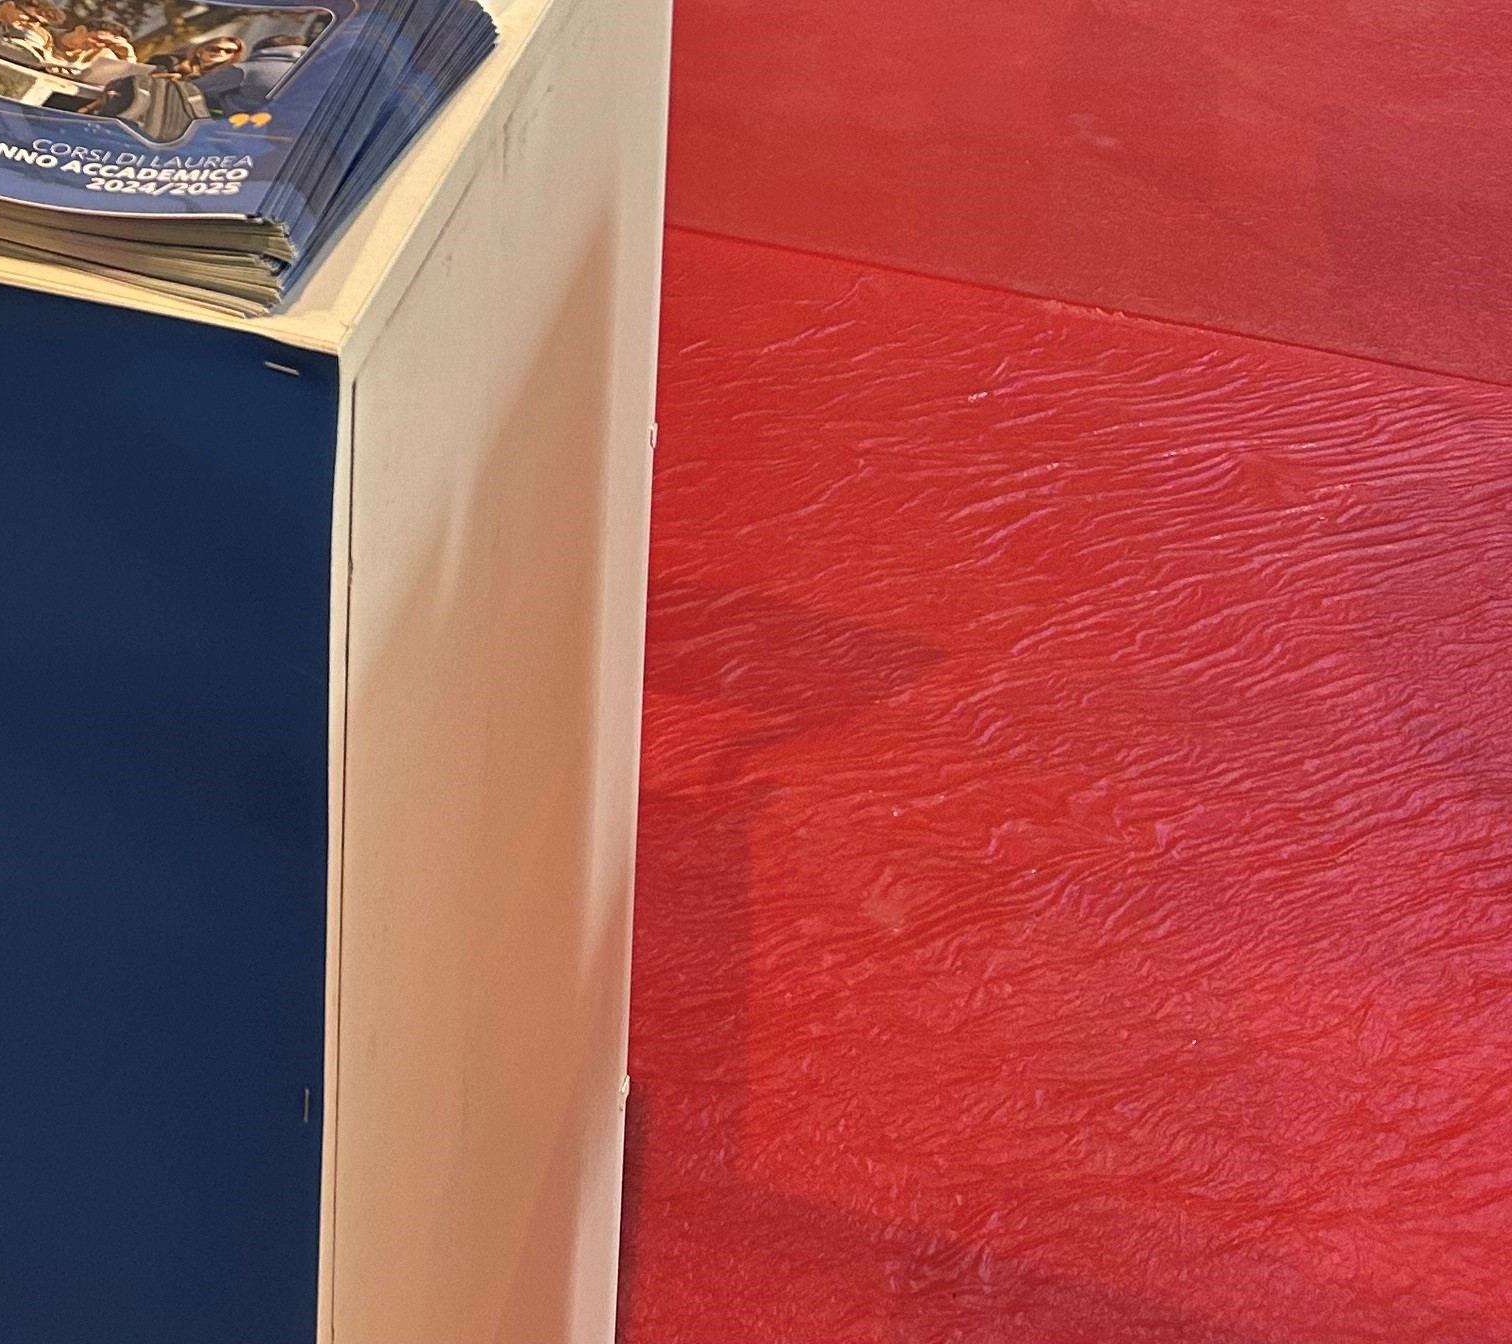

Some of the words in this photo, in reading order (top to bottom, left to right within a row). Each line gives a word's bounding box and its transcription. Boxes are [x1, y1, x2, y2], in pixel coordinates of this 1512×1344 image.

[31, 137, 113, 164] CORSI
[115, 151, 145, 166] DI
[151, 154, 255, 169] LAUREA
[59, 160, 250, 182] ACCADEMICO
[85, 177, 243, 196] 2024/2025
